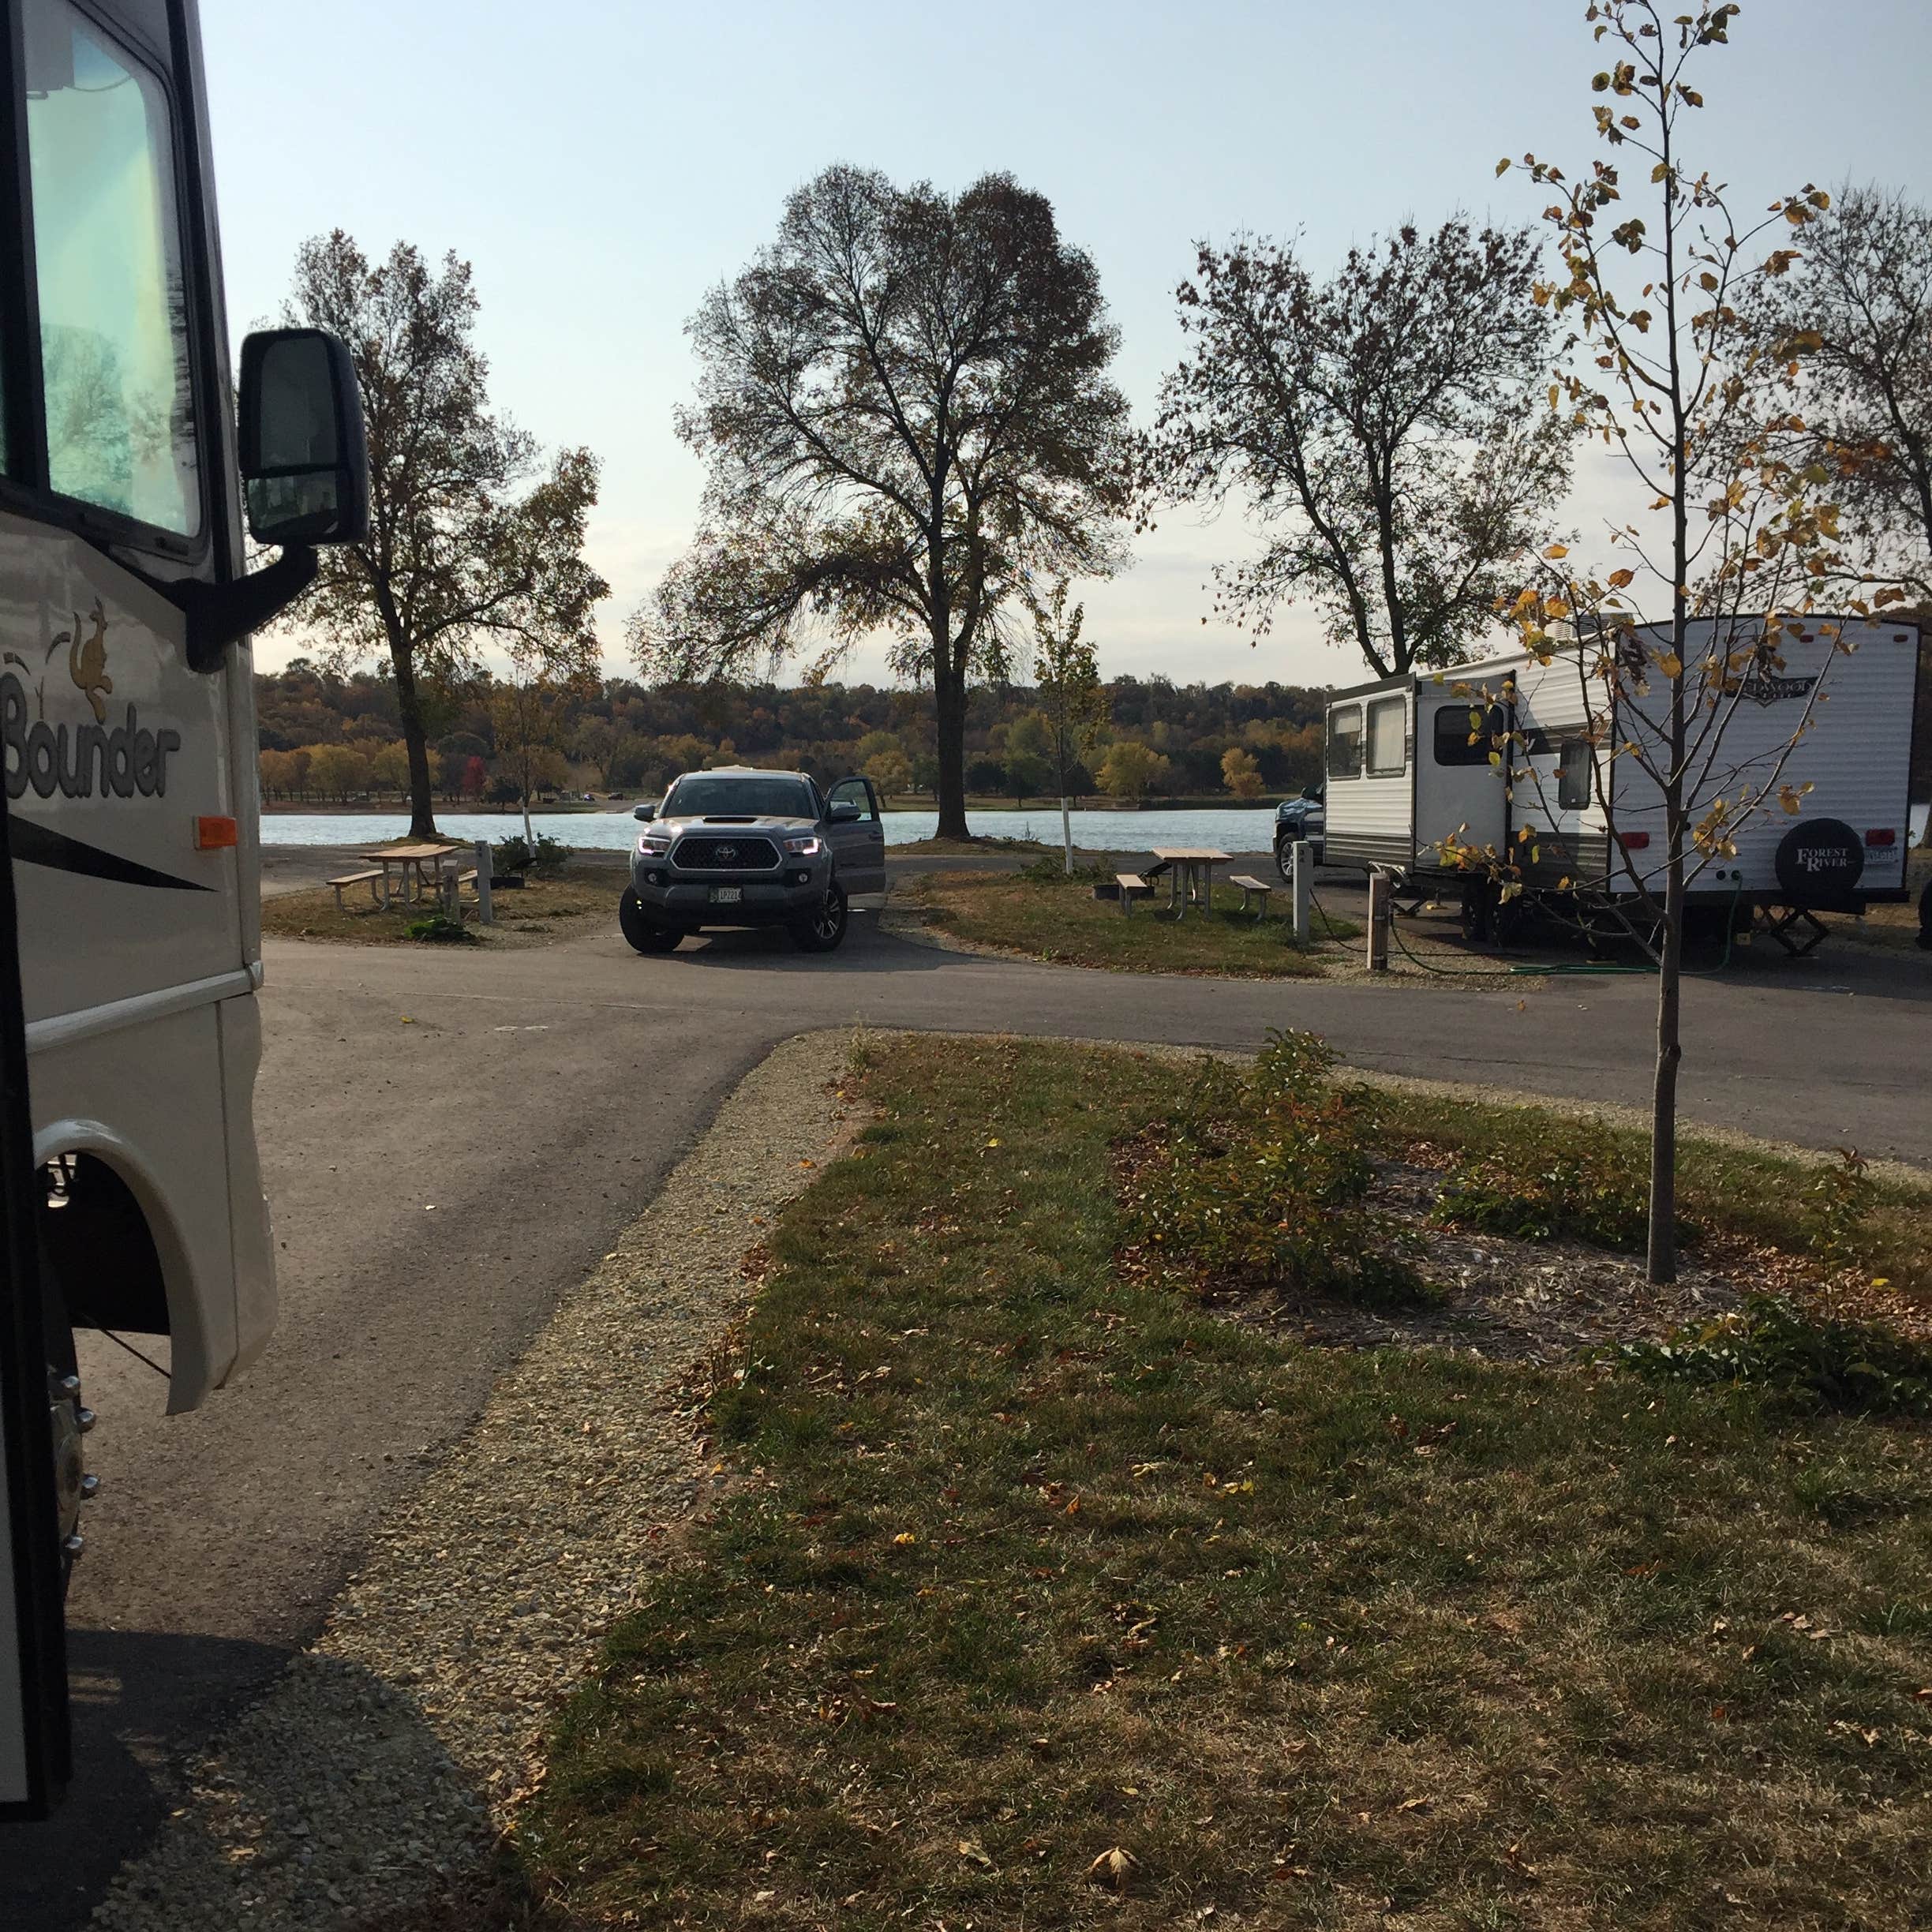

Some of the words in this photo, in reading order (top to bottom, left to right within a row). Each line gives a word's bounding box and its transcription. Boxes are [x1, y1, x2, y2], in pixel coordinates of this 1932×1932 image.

[2, 672, 181, 799] Bounder
[1795, 848, 1848, 865] FOREST
[1807, 857, 1848, 871] RIVER
